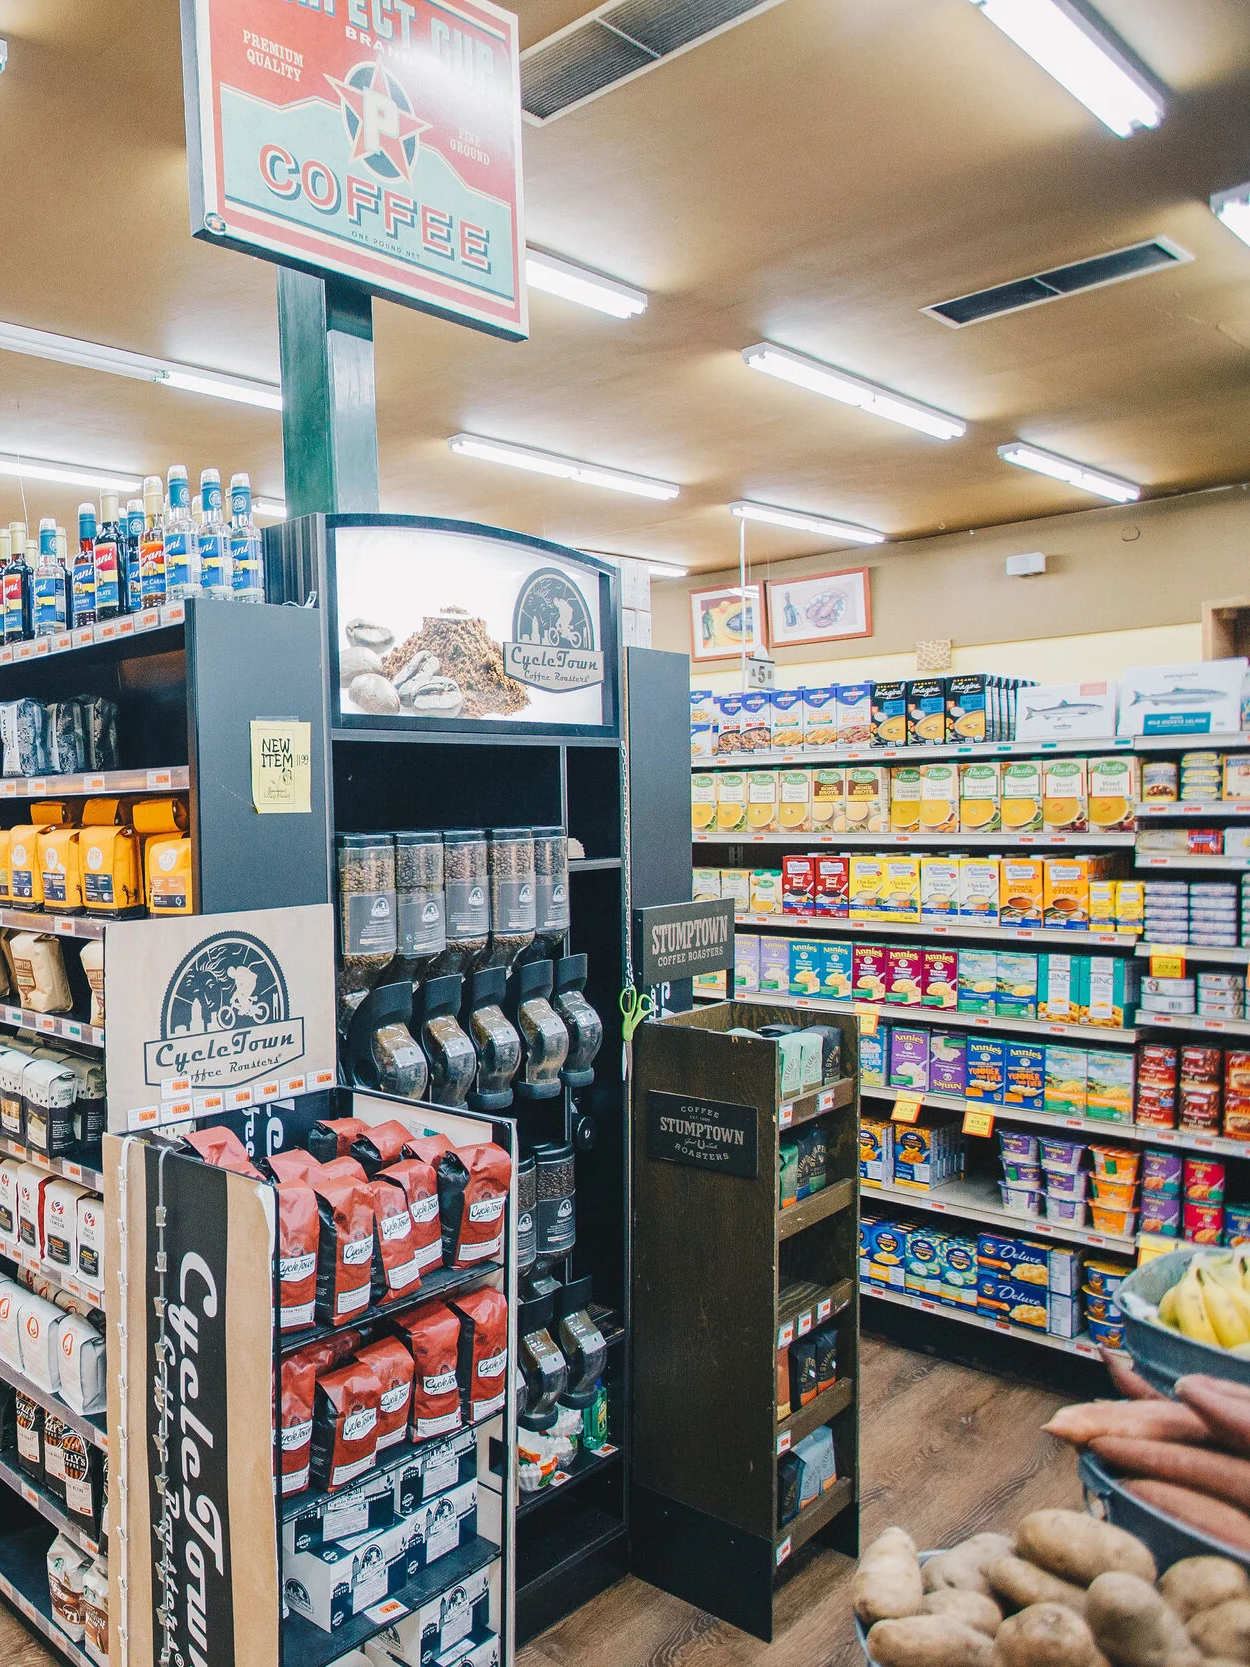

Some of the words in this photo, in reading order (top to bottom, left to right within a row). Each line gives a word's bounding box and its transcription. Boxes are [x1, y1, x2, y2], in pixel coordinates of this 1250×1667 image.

[242, 29, 304, 68] PREMIUM
[246, 48, 302, 82] QUALITY
[449, 138, 491, 166] GROUND
[259, 143, 493, 275] COFFEE
[351, 230, 370, 243] ONE
[511, 646, 599, 671] CycleTown
[524, 670, 551, 681] Coffee
[757, 665, 767, 684] 5
[722, 718, 741, 726] STOC
[261, 738, 291, 754] NEW
[261, 753, 293, 768] ITEM
[651, 914, 728, 955] STUMPTOWN
[657, 954, 687, 968] COFFEE
[688, 946, 724, 964] ROASTERS
[155, 1029, 295, 1072] CycleTown
[229, 1055, 280, 1073] Roasters
[681, 1106, 720, 1119] COFFEE
[660, 1116, 745, 1146] STUMPTOWN
[674, 1142, 730, 1161] ROASTERS
[998, 1243, 1043, 1265] Deluxe
[997, 1284, 1042, 1306] Deluxe
[16, 1400, 35, 1416] ULLY'S
